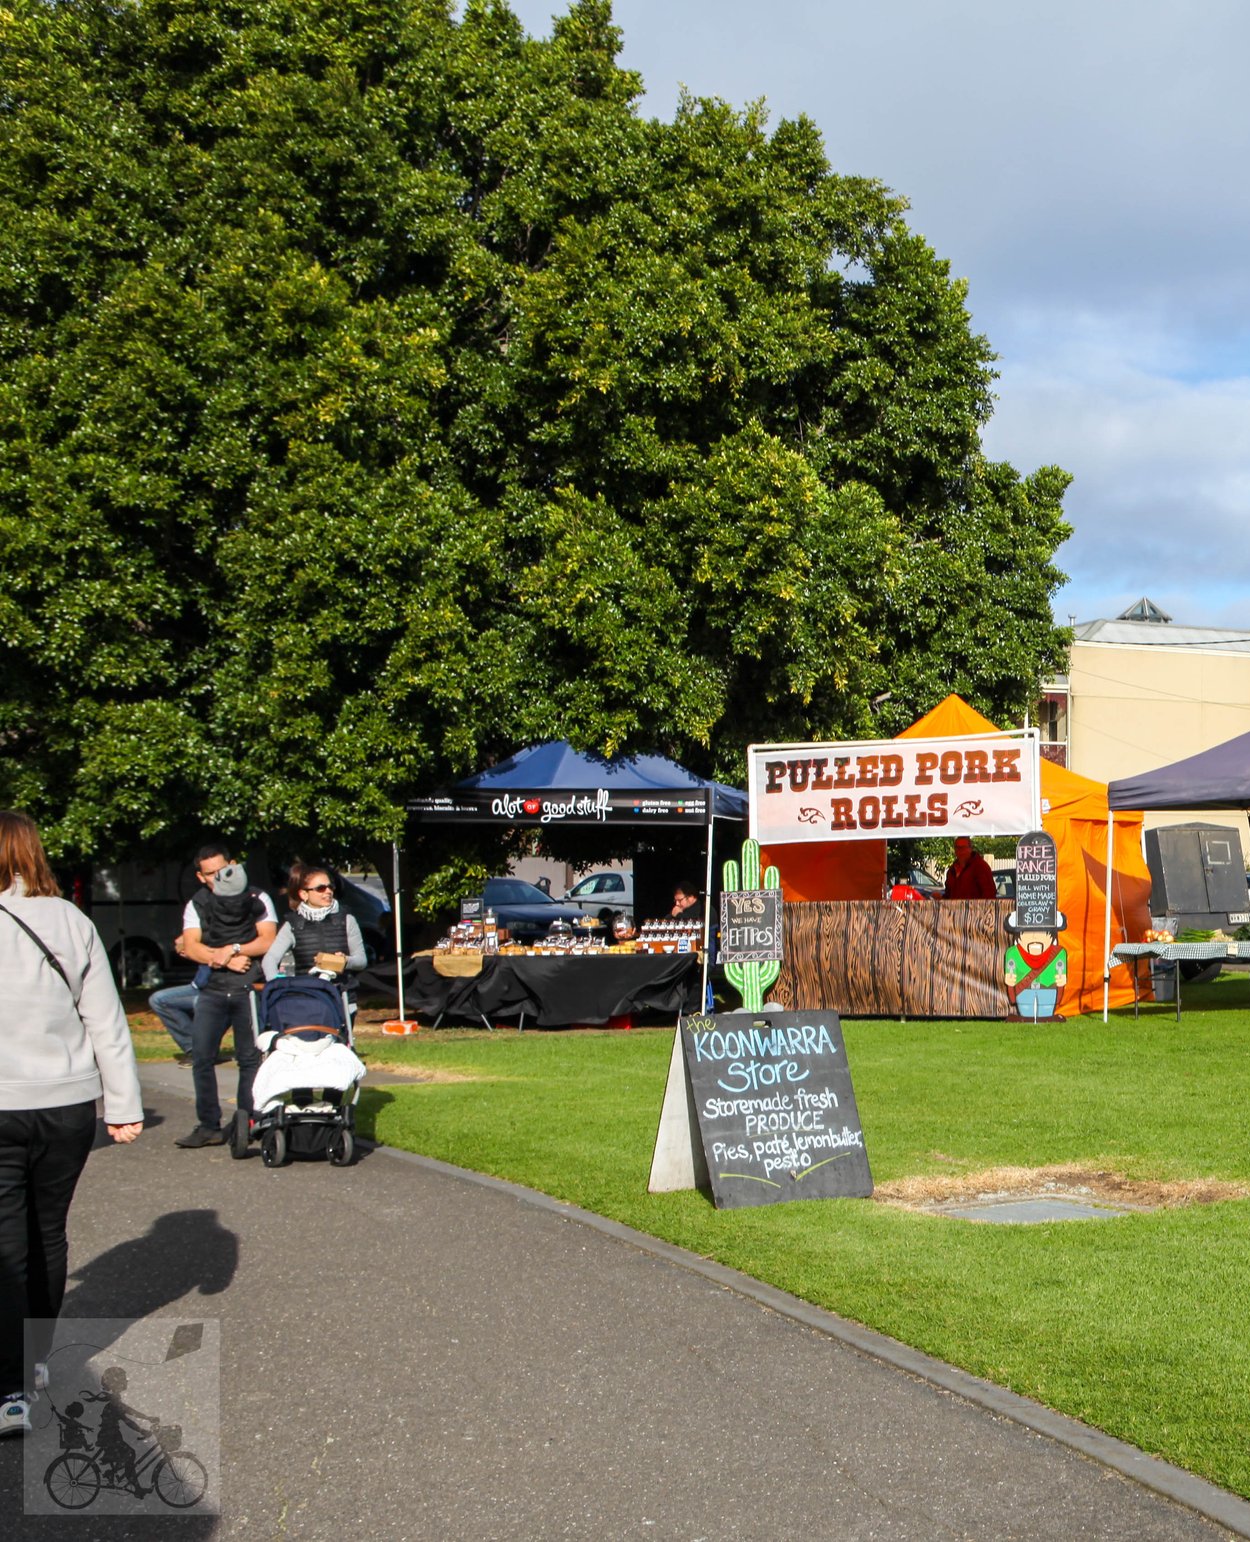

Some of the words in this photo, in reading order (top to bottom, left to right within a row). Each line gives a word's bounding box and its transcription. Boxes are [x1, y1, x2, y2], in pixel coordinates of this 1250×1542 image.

[765, 753, 905, 794] PULLED
[914, 748, 1022, 786] PORK
[830, 792, 949, 831] ROLLS
[1018, 845, 1053, 859] FREE
[1017, 860, 1054, 873] RANGE
[731, 898, 766, 915] YES
[729, 926, 774, 946] EFTPOS
[686, 1017, 717, 1034] the
[693, 1024, 838, 1063] KOONWARRA
[717, 1059, 810, 1093] Store
[702, 1091, 794, 1119] Storemade
[794, 1086, 839, 1110] fresh
[745, 1110, 825, 1136] PRODUCE
[712, 1142, 753, 1163] Pies,
